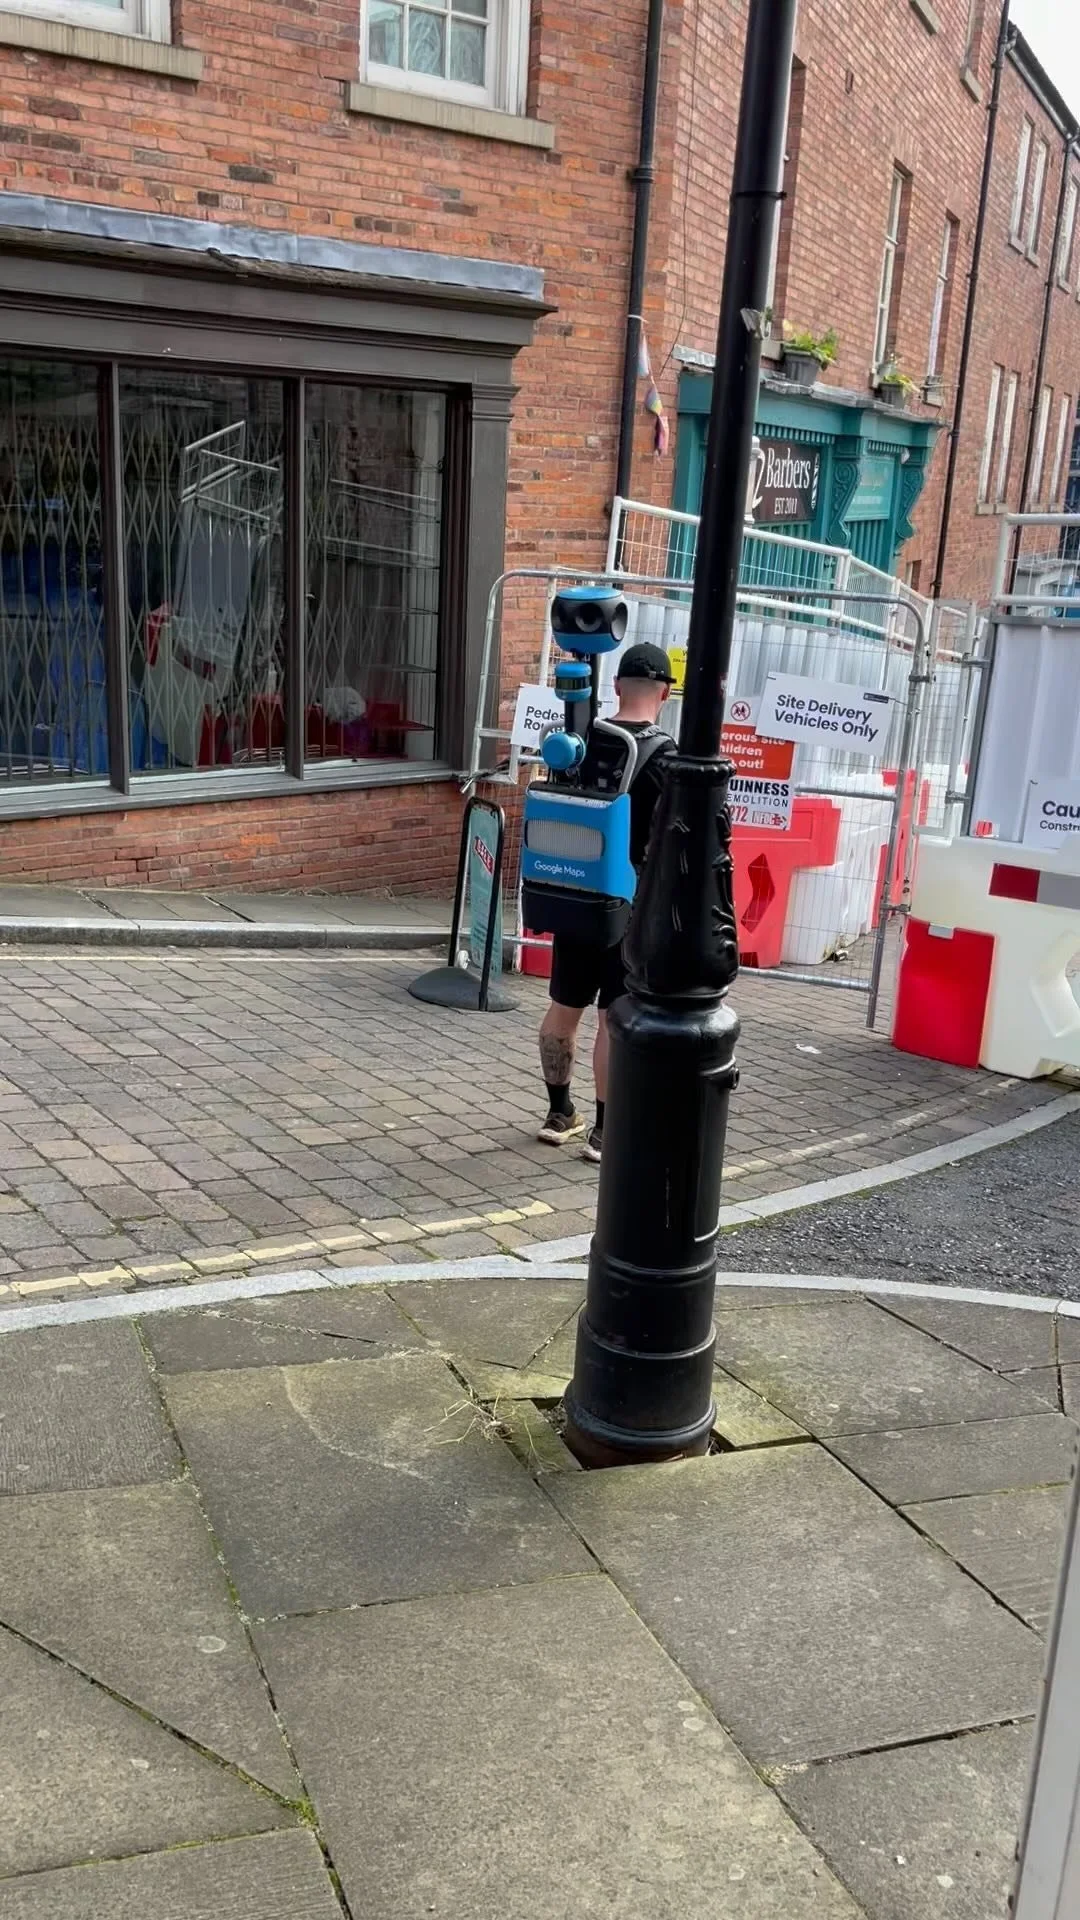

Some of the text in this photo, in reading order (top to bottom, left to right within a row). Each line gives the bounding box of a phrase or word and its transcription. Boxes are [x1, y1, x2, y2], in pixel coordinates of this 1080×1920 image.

[765, 447, 811, 488] Barbers
[774, 497, 785, 515] EST
[526, 705, 566, 721] Pedes
[777, 694, 872, 724] Site Delivery
[775, 709, 879, 742] Vehicles Only
[721, 732, 757, 743] erous
[720, 743, 763, 756] hildren
[738, 759, 764, 769] out!
[729, 779, 789, 797] UINNESS
[727, 793, 789, 807] EMOLITION
[1040, 820, 1080, 831] Constr
[534, 860, 586, 878] Google Maps
